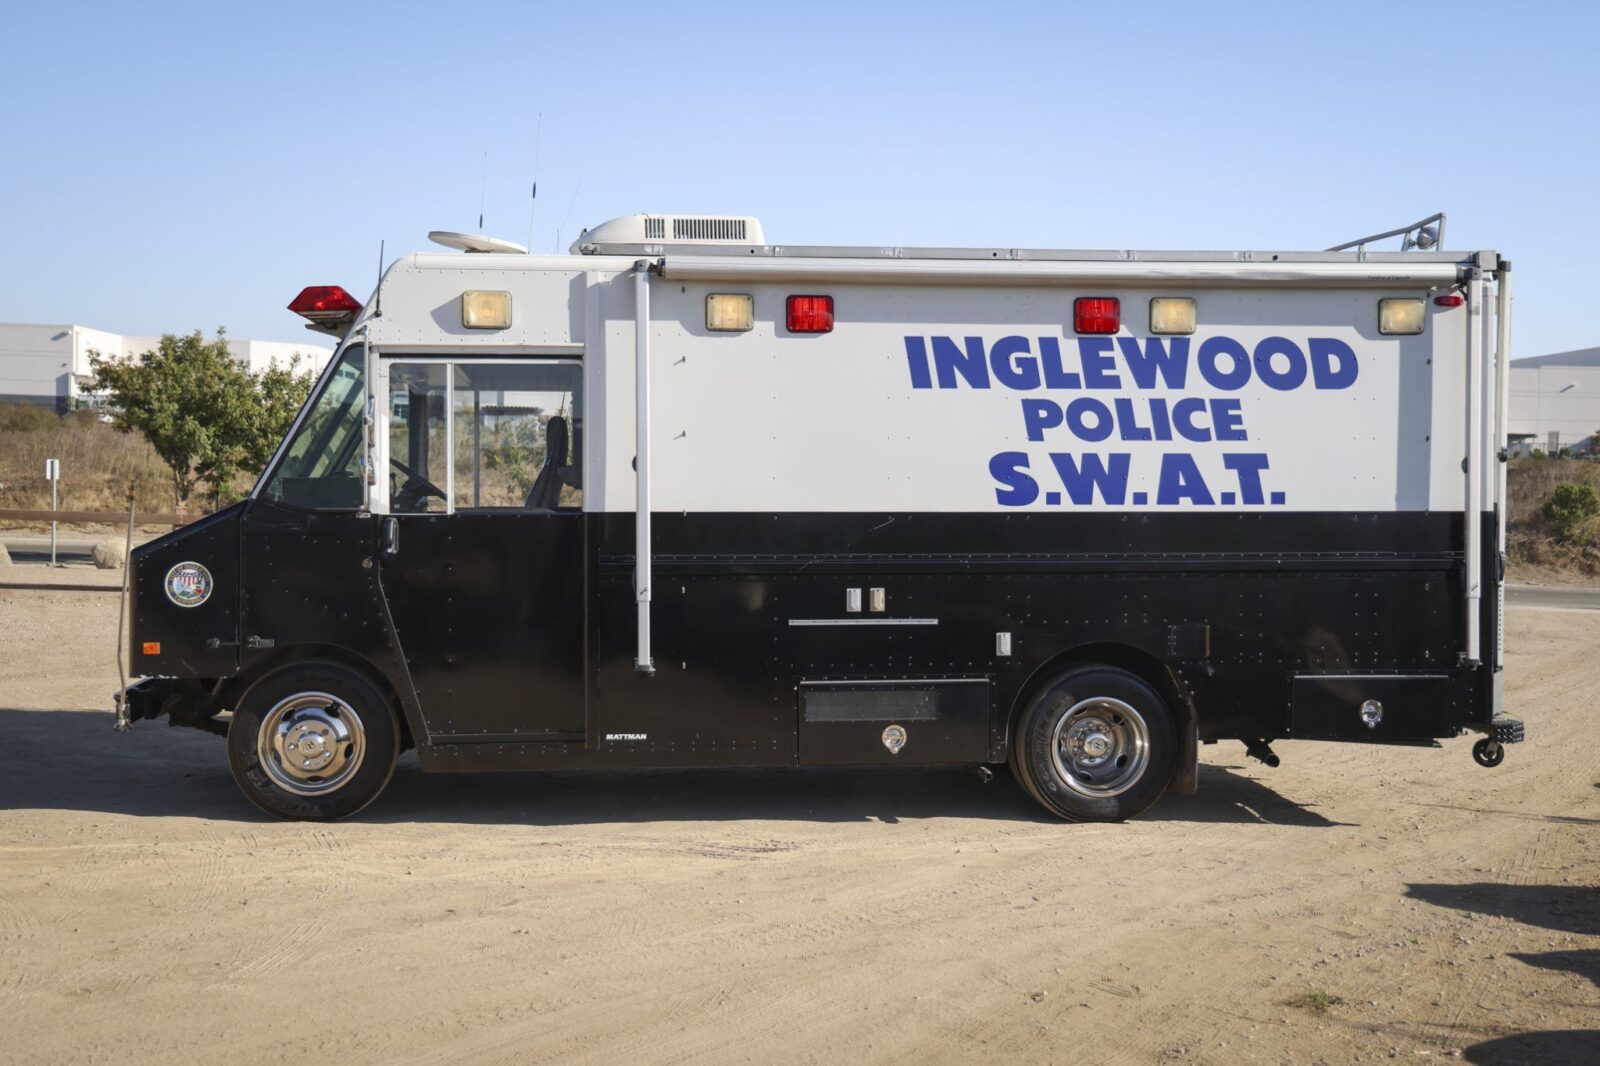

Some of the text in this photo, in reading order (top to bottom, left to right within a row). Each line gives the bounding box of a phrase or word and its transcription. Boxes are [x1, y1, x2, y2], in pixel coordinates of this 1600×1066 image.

[904, 335, 1359, 391] INGLEWOOD
[1021, 397, 1248, 442] POLICE
[988, 451, 1286, 506] S.W.A.T.
